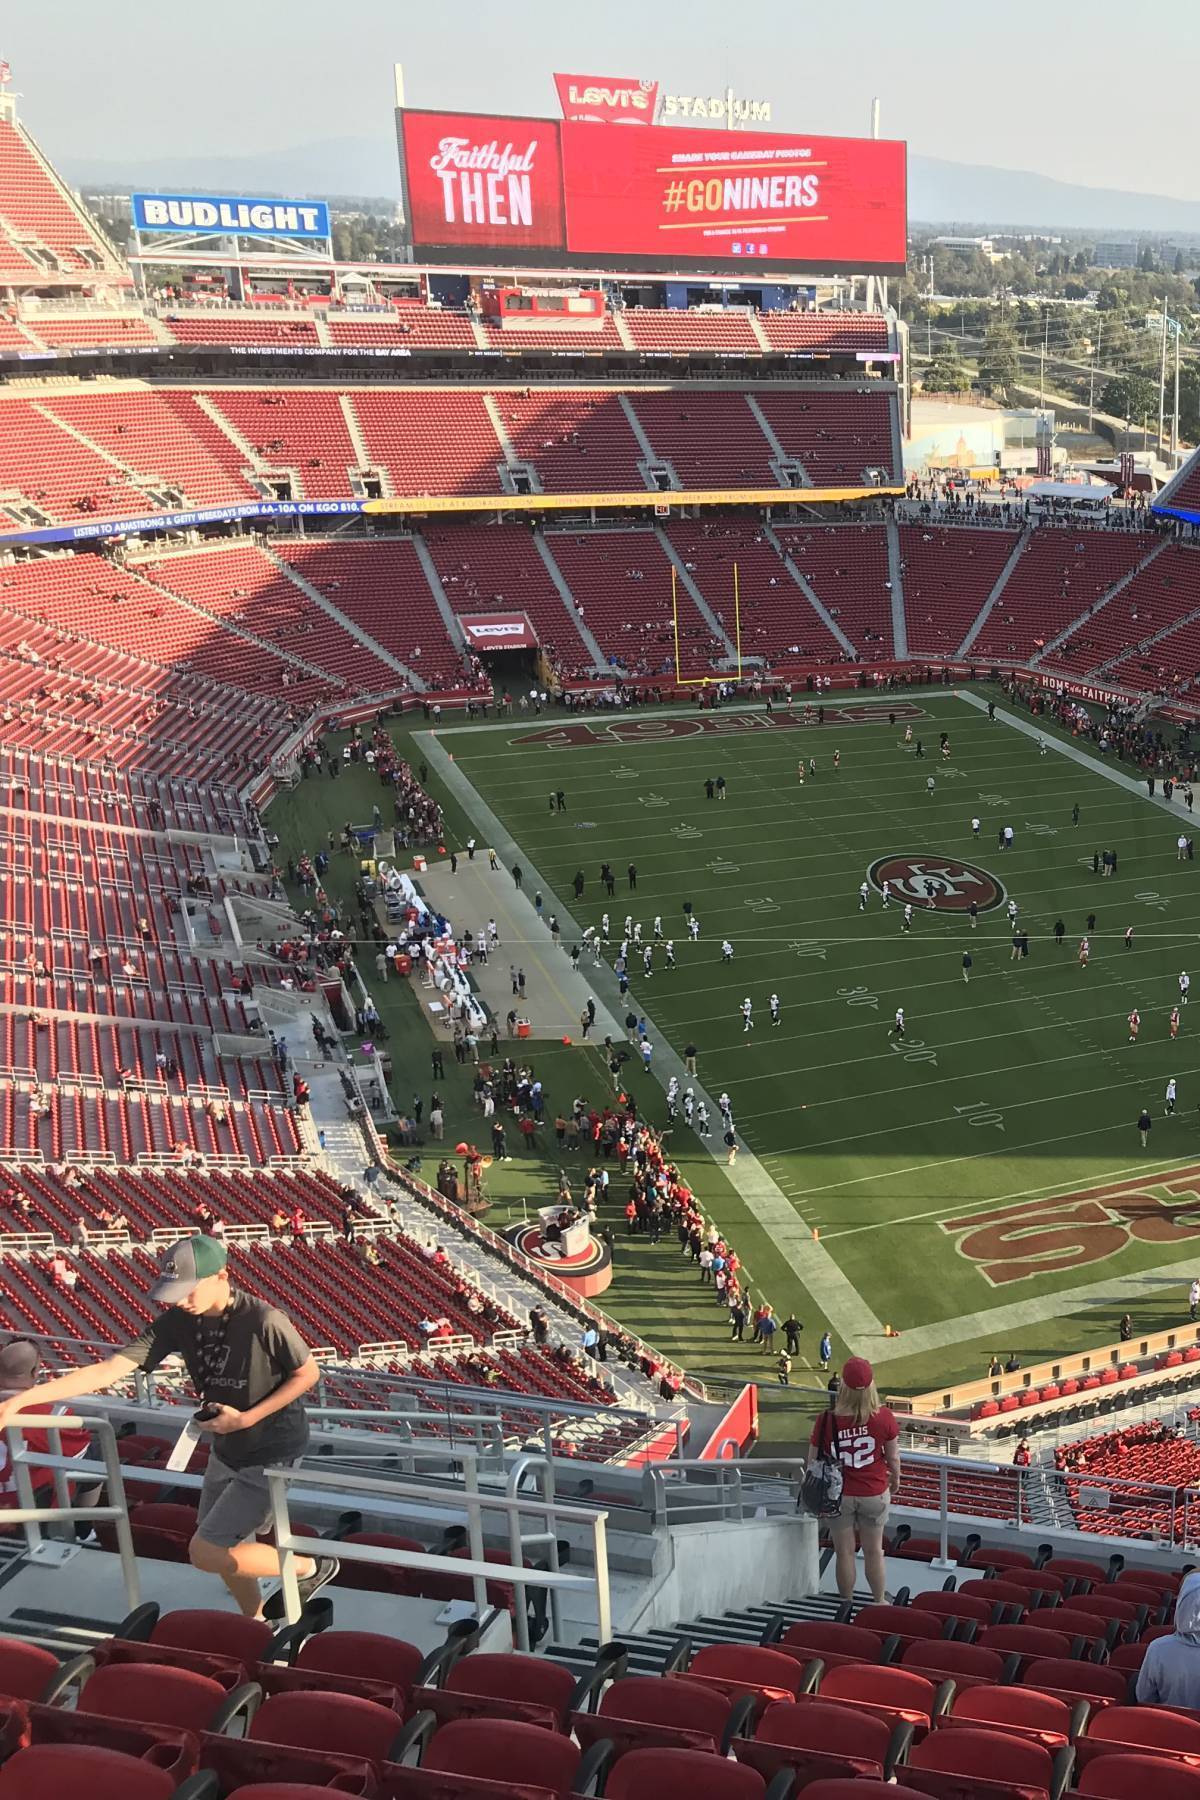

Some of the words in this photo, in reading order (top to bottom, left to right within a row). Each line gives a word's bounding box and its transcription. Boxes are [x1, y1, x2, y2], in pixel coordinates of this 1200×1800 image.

[430, 136, 538, 177] Faithful
[436, 170, 533, 226] THEN
[662, 174, 819, 213] #GONINERS
[144, 200, 219, 226] BUD
[221, 204, 318, 231] LIGHT
[73, 526, 100, 537] LISTEN
[100, 525, 112, 534] TO
[261, 503, 296, 514] 6A-10A
[298, 503, 313, 512] ON
[316, 502, 338, 512] KGO
[836, 986, 879, 1006] 30
[890, 1040, 937, 1062] 20
[953, 1101, 1004, 1126] 10
[830, 1435, 876, 1469] 52
